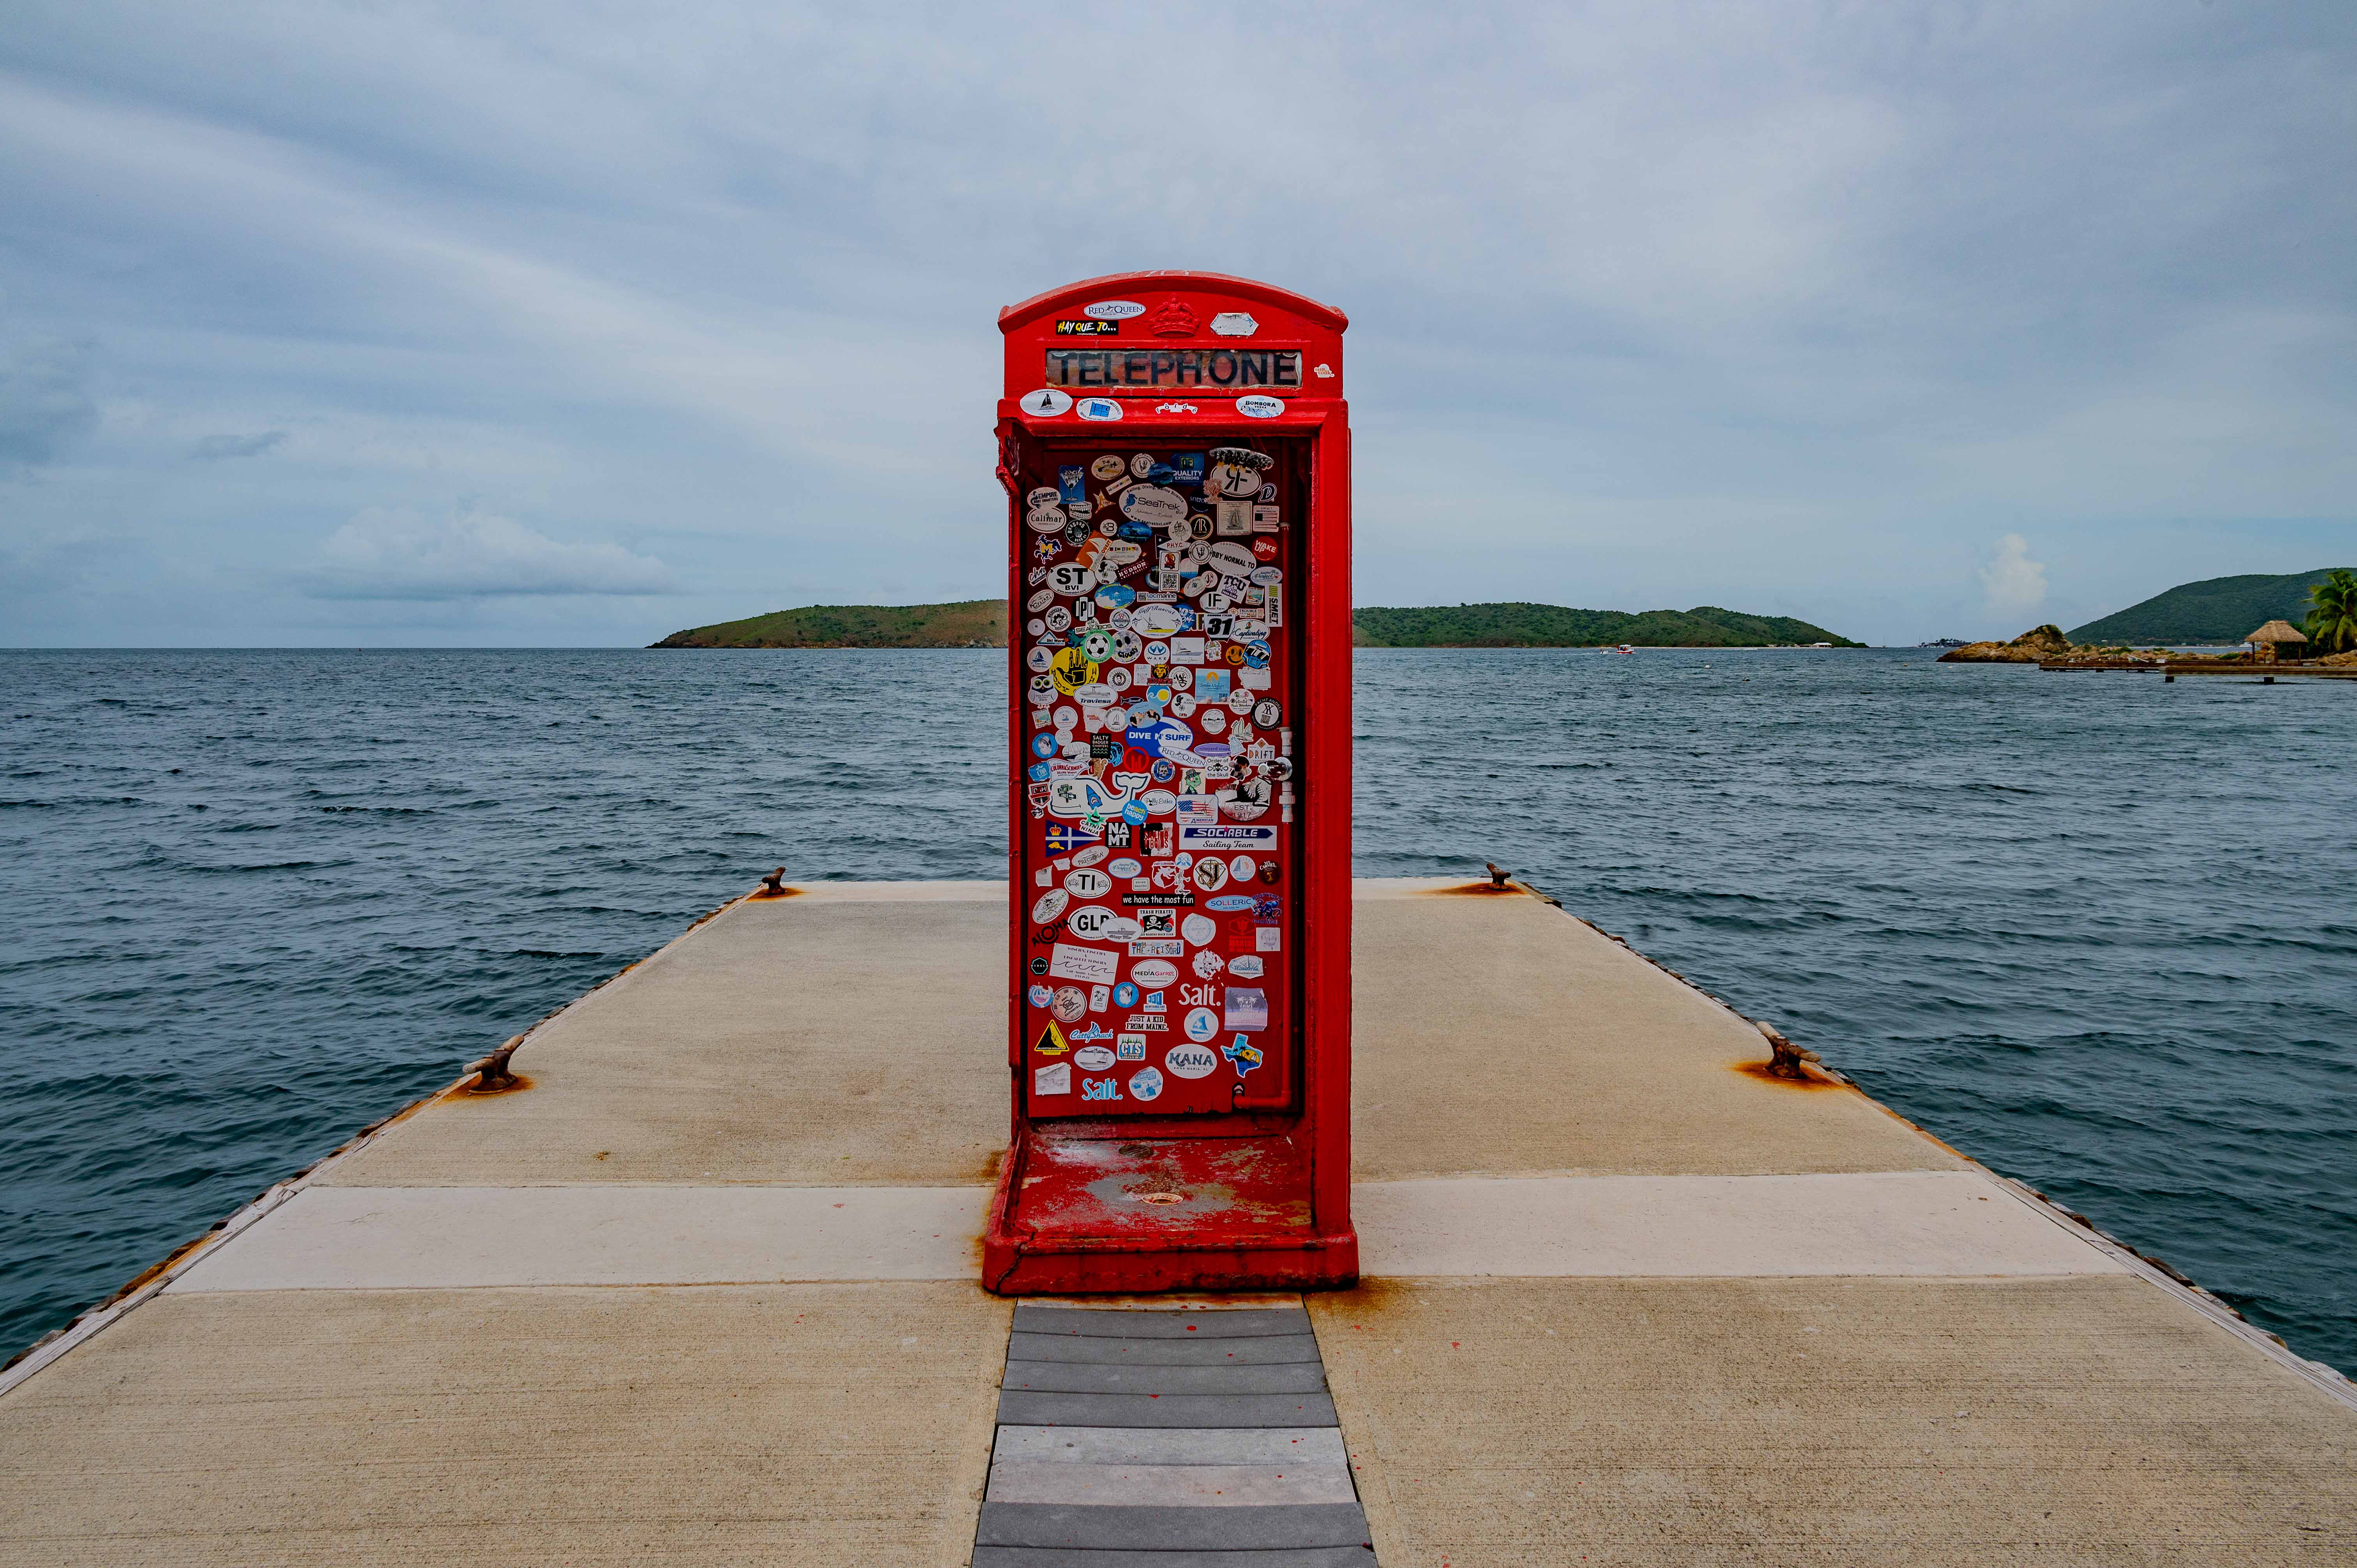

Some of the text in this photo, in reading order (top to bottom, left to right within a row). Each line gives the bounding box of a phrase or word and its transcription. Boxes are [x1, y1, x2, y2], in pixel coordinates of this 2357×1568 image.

[1114, 306, 1142, 314] QUEEN
[1058, 321, 1074, 334] HAY
[1076, 323, 1094, 332] QUE
[1051, 351, 1298, 385] TELEPHONE
[1171, 491, 1184, 503] Science
[1138, 498, 1180, 511] SeaTrek
[1256, 540, 1277, 553] WAKE
[1212, 551, 1223, 559] BBY
[1224, 555, 1246, 567] NORMAL
[1118, 562, 1146, 577] HUDSON
[1057, 568, 1088, 584] ST
[1224, 575, 1247, 591] TCU
[1209, 594, 1221, 607] IF
[1207, 618, 1233, 635] 31
[1235, 628, 1267, 640] Captivating
[1118, 646, 1138, 658] Cloudy
[1254, 698, 1282, 712] YACHT ANDREA
[1162, 747, 1205, 766] RED QUEEN
[1249, 750, 1273, 759] DRIFT
[1124, 809, 1144, 821] happy
[1127, 803, 1145, 815] beach
[1081, 821, 1103, 830] CATNIP
[1081, 826, 1099, 835] NINJA
[1108, 823, 1129, 834] NA
[1193, 828, 1258, 837] SOCIABLE
[1108, 835, 1129, 846] MT
[1203, 841, 1232, 850] Sailing
[1078, 874, 1095, 890] TI
[1134, 895, 1149, 904] have
[1151, 895, 1163, 903] the
[1178, 984, 1221, 1006] Salt.
[1121, 1042, 1141, 1054] CTS
[1082, 1079, 1123, 1100] Salt.
